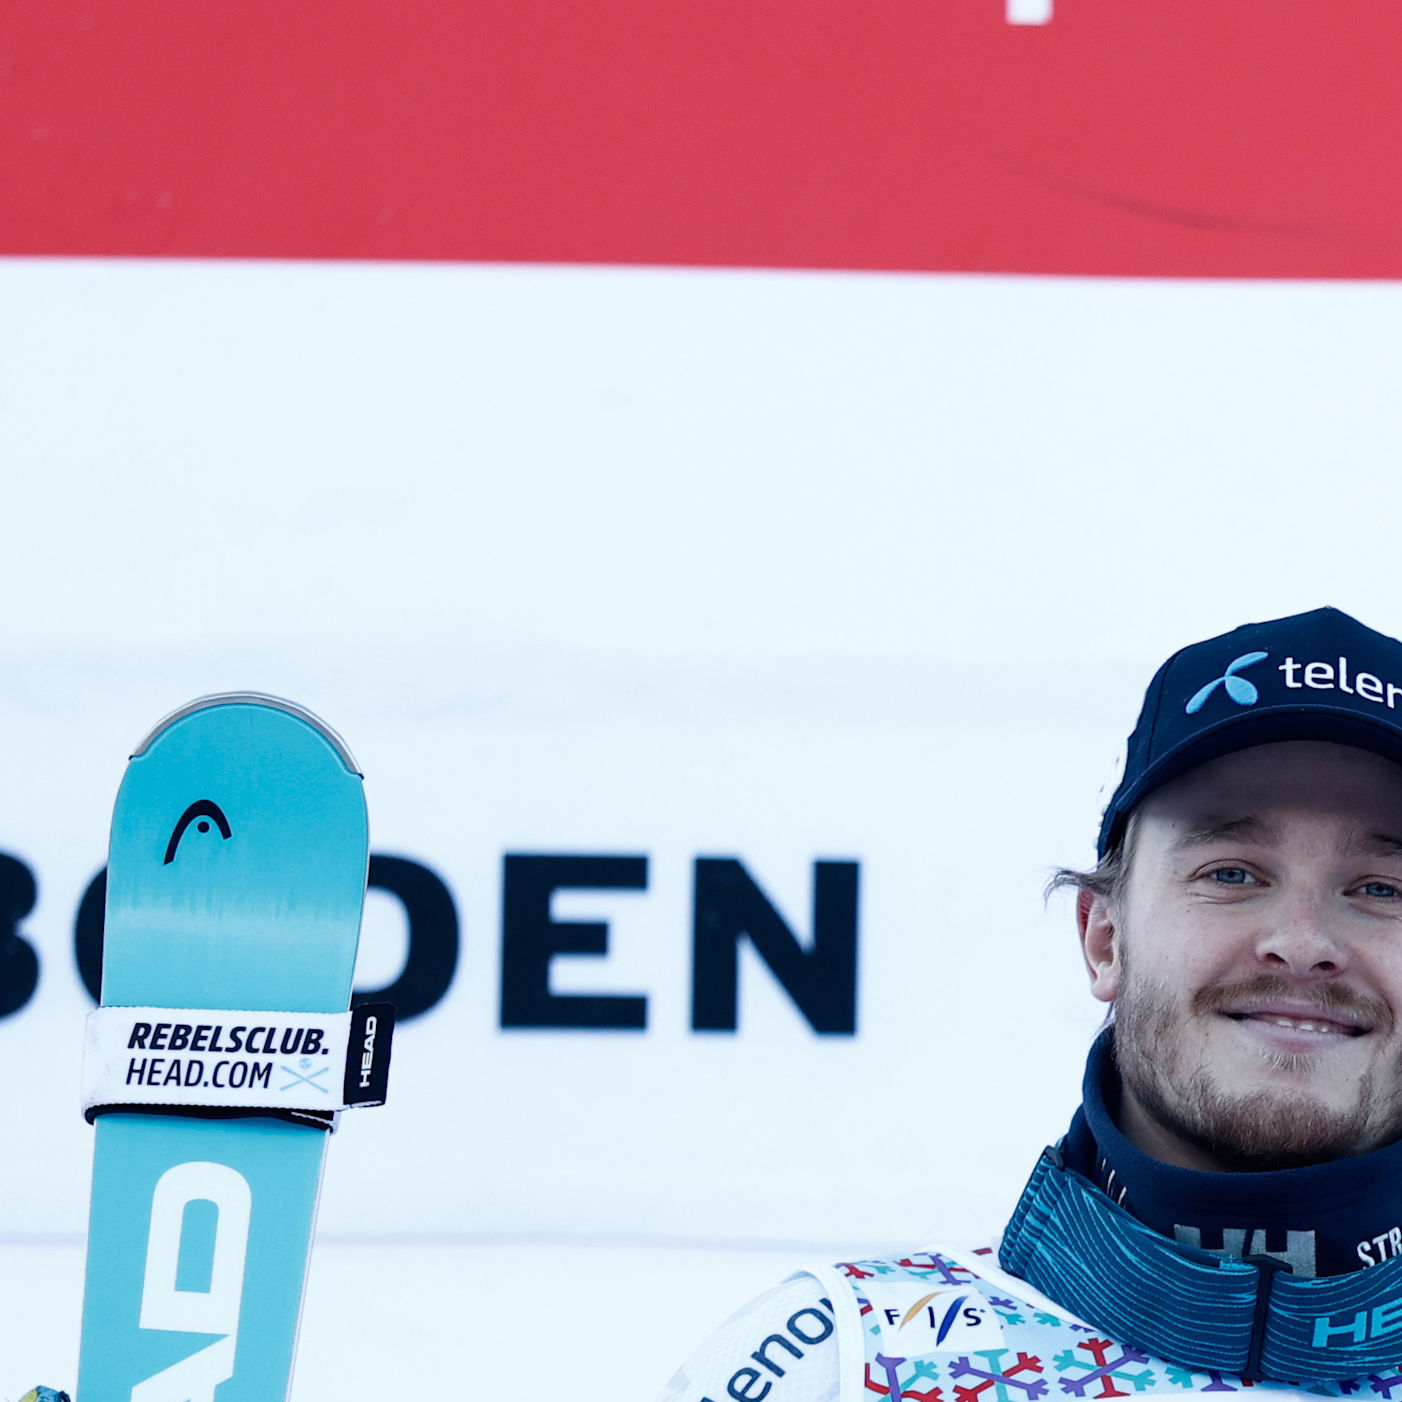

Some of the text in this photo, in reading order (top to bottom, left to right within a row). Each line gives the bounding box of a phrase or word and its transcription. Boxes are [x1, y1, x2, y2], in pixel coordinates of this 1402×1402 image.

[127, 1022, 329, 1055] REBELSCLUB.
[359, 1016, 377, 1088] HEAD
[125, 1057, 273, 1089] HEAD.COM
